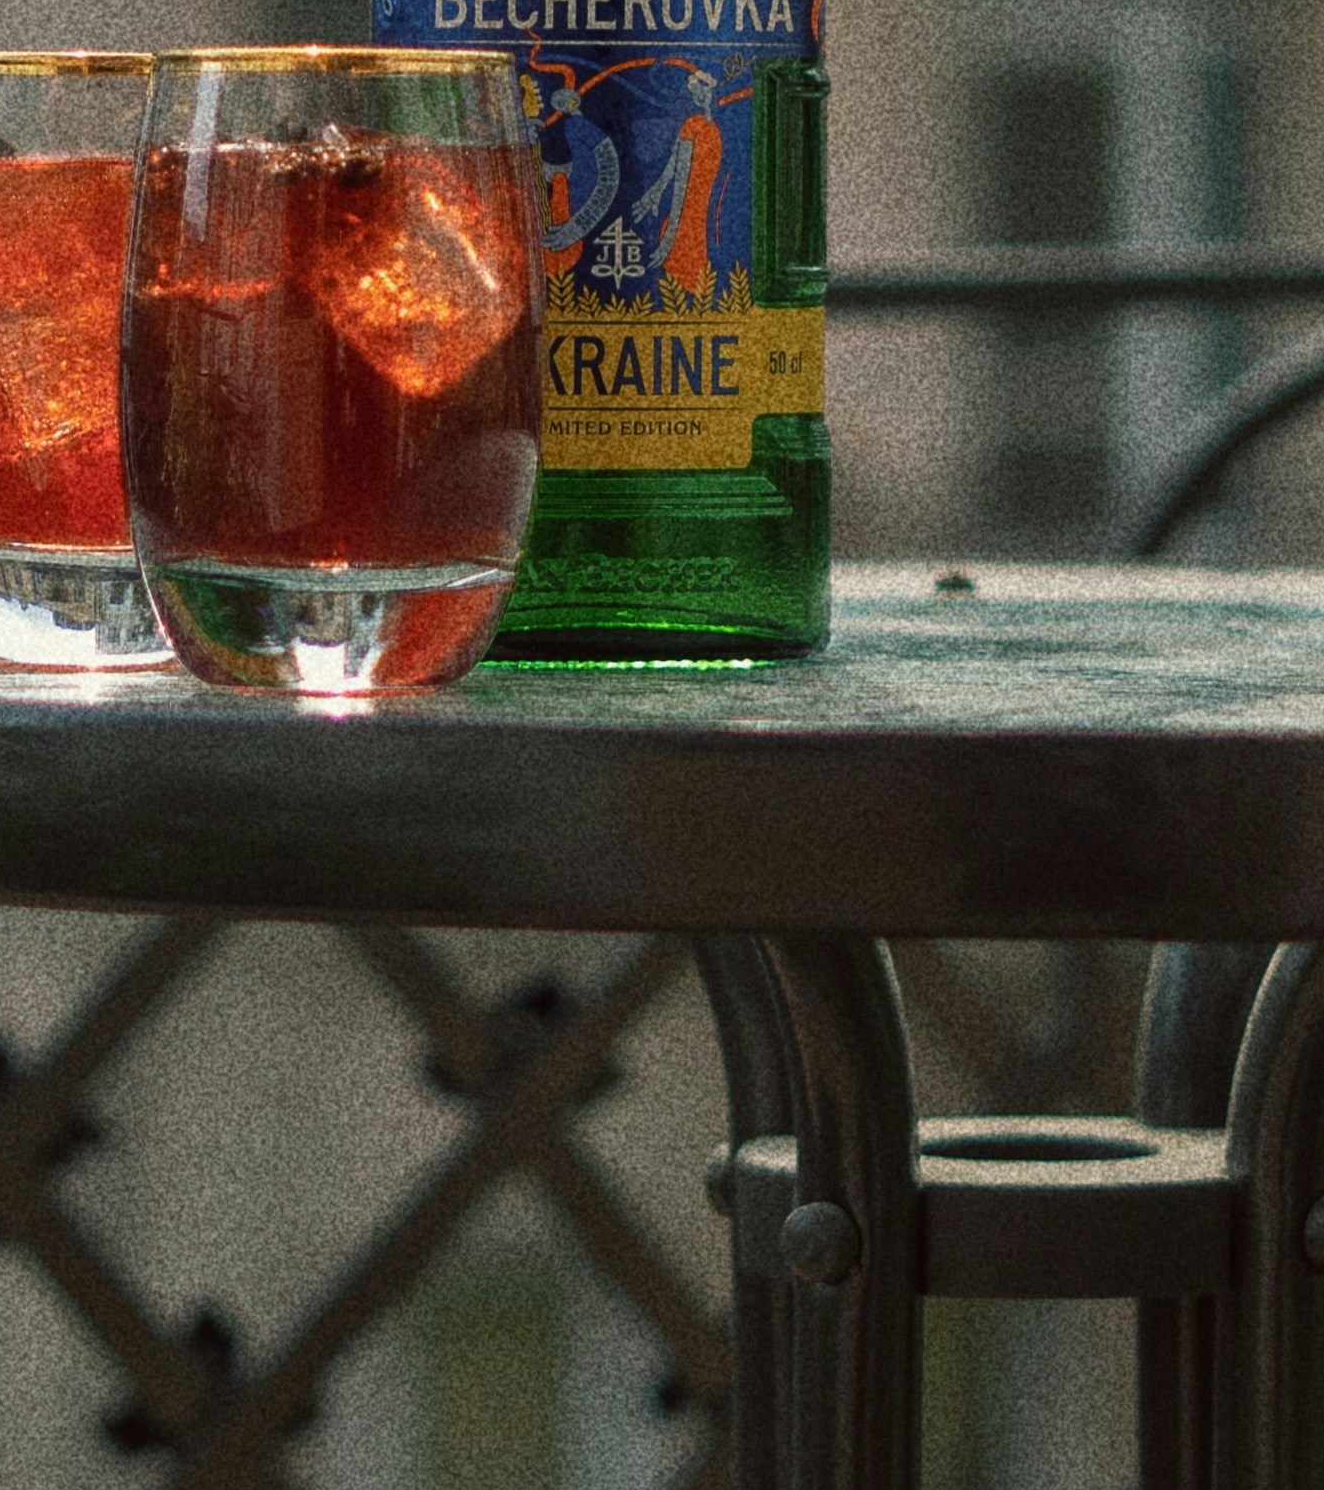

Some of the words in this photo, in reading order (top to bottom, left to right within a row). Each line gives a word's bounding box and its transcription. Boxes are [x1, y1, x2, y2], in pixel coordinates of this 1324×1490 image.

[548, 335, 739, 396] KRAINE
[769, 351, 786, 375] 50
[791, 352, 802, 374] cl
[548, 421, 612, 436] MITED
[620, 421, 702, 436] EDITION
